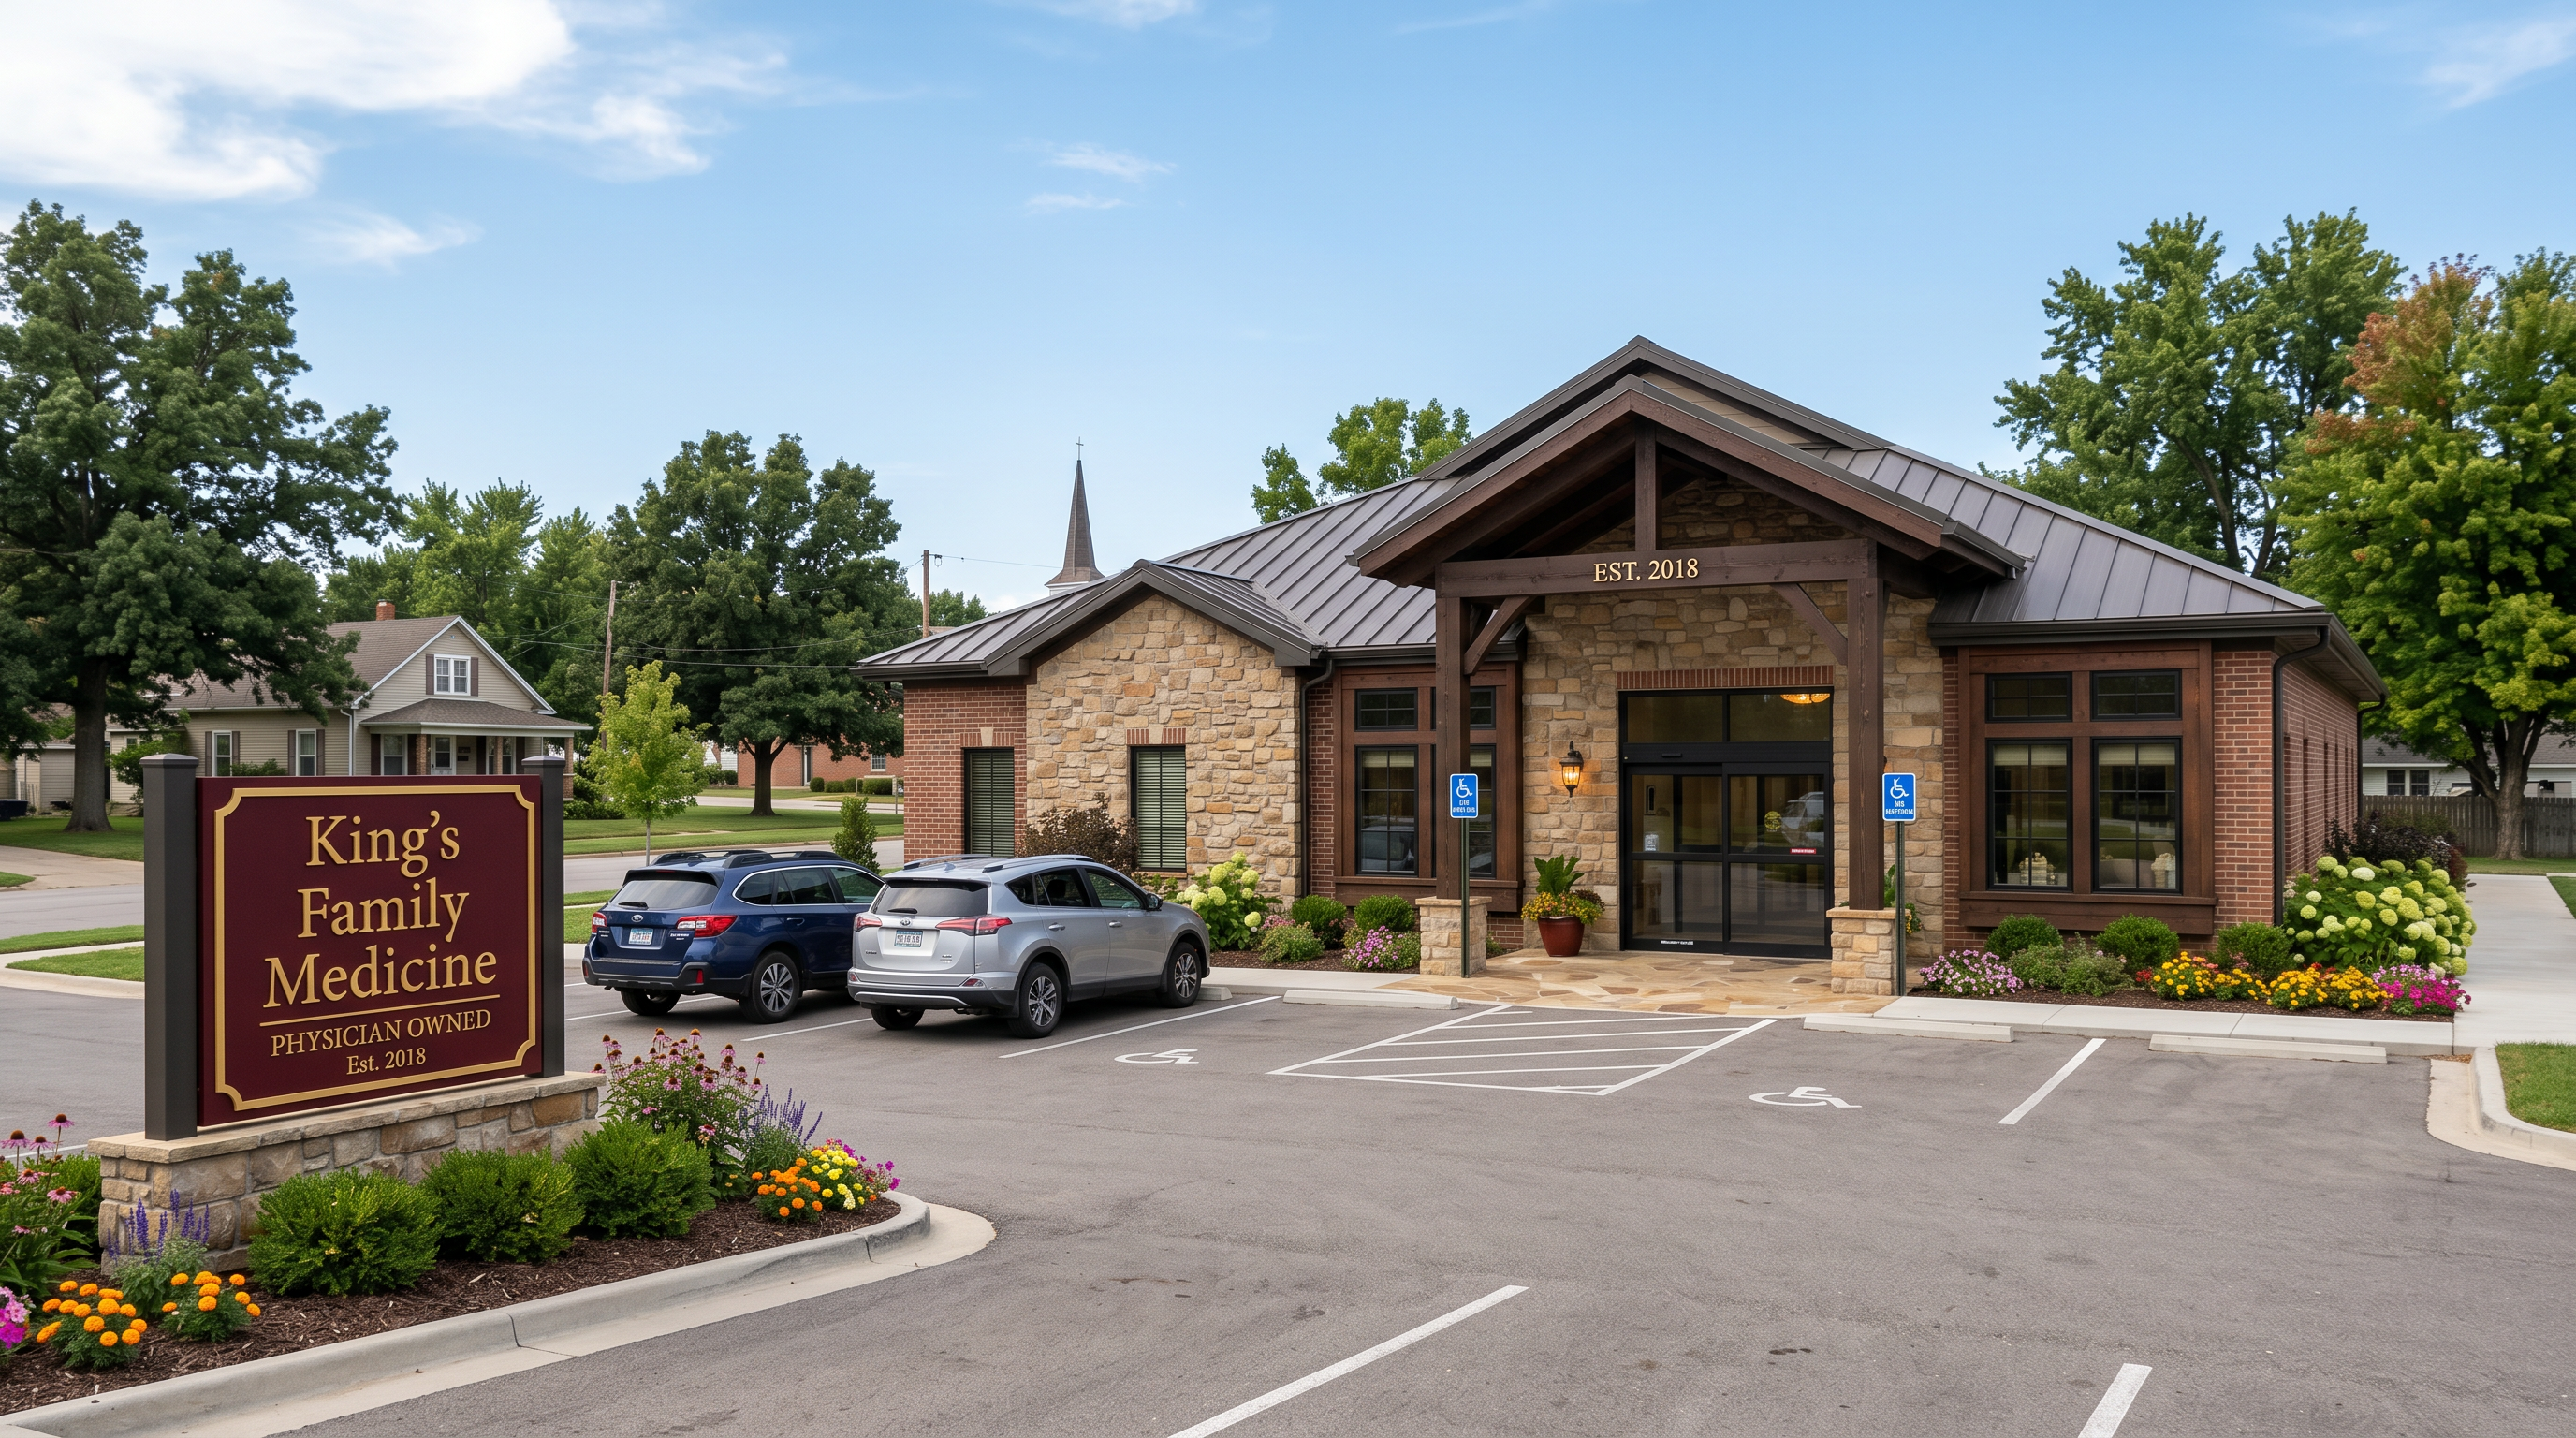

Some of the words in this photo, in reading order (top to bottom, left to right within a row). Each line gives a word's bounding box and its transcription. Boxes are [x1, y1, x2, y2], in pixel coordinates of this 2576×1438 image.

[1593, 562, 1641, 582] EST.
[1647, 558, 1699, 580] 2018
[305, 810, 461, 878] King's
[297, 876, 470, 943] Family
[262, 943, 498, 1009] Medicine
[270, 1020, 402, 1057] PHYSICIAN
[407, 1009, 491, 1038] OWNED
[346, 1055, 379, 1075] Est.
[385, 1047, 427, 1068] 2018
